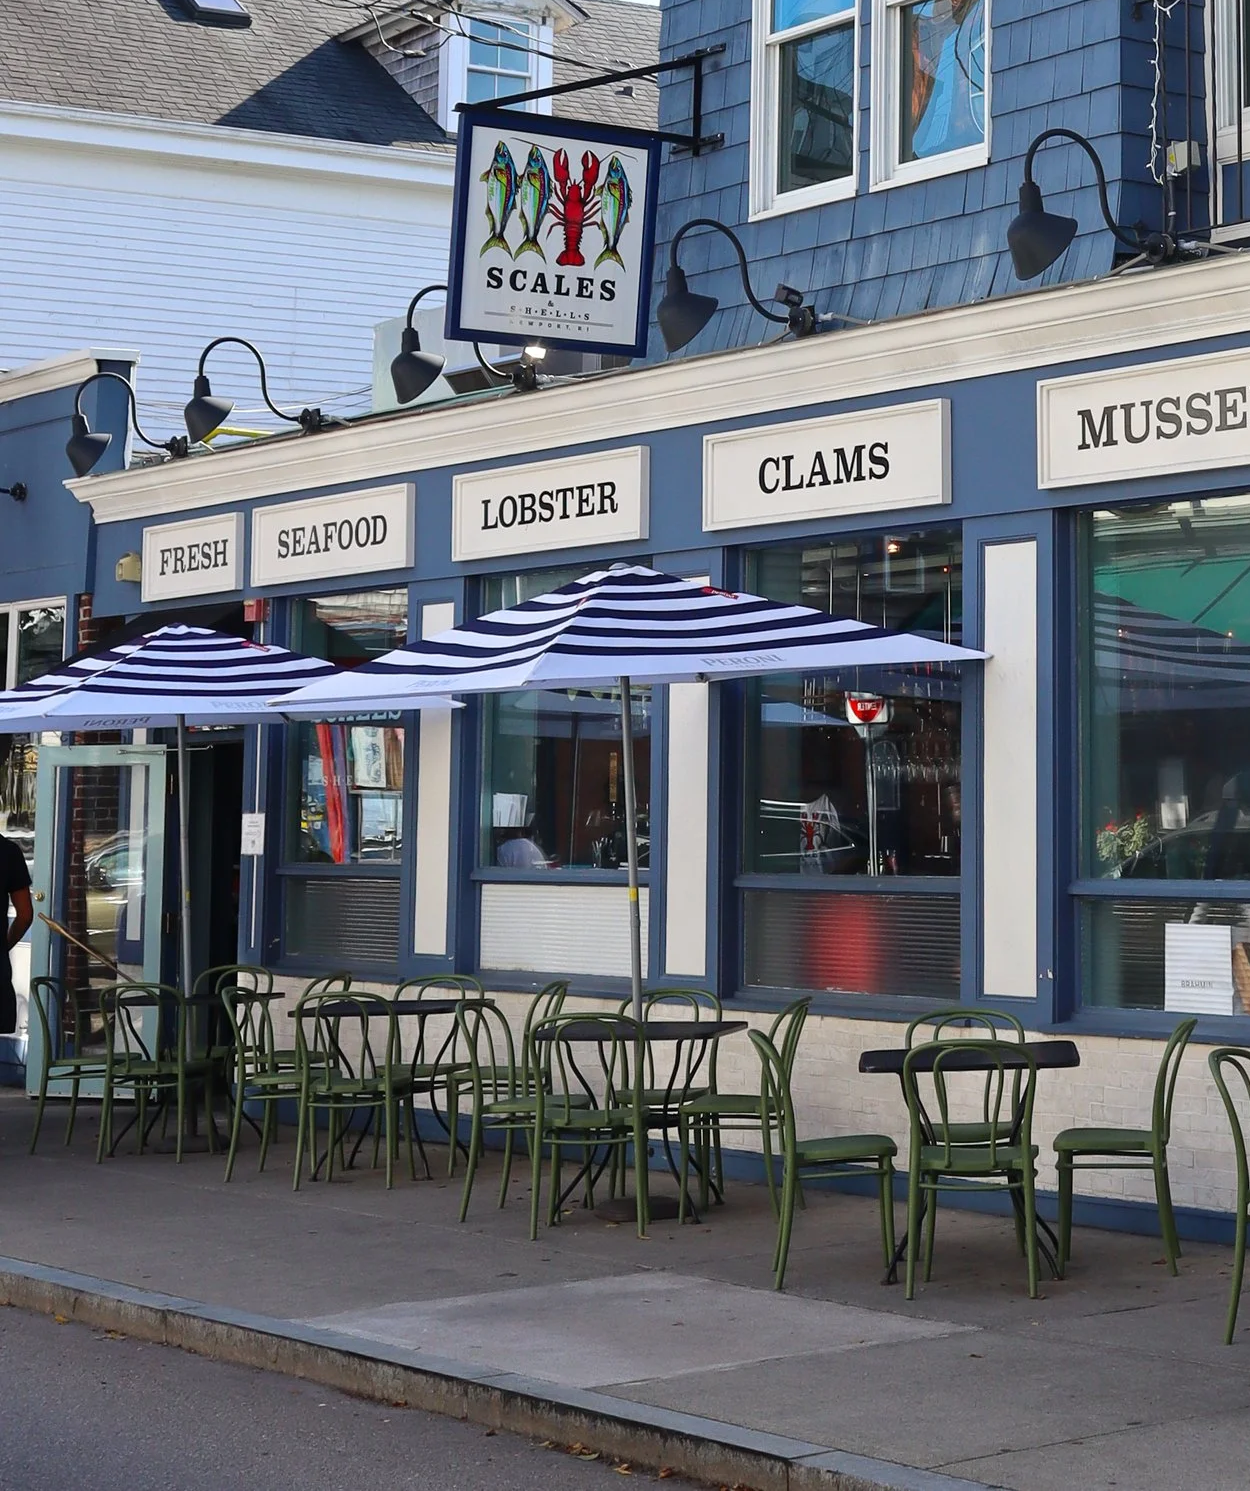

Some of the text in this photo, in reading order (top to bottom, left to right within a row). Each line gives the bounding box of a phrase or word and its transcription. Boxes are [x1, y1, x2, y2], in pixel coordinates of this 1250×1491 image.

[486, 266, 616, 301] SCALES
[757, 441, 891, 494] CLAMS
[481, 481, 619, 530] LOBSTER
[159, 539, 229, 576] FRESH
[277, 514, 388, 559] SEAFOOD
